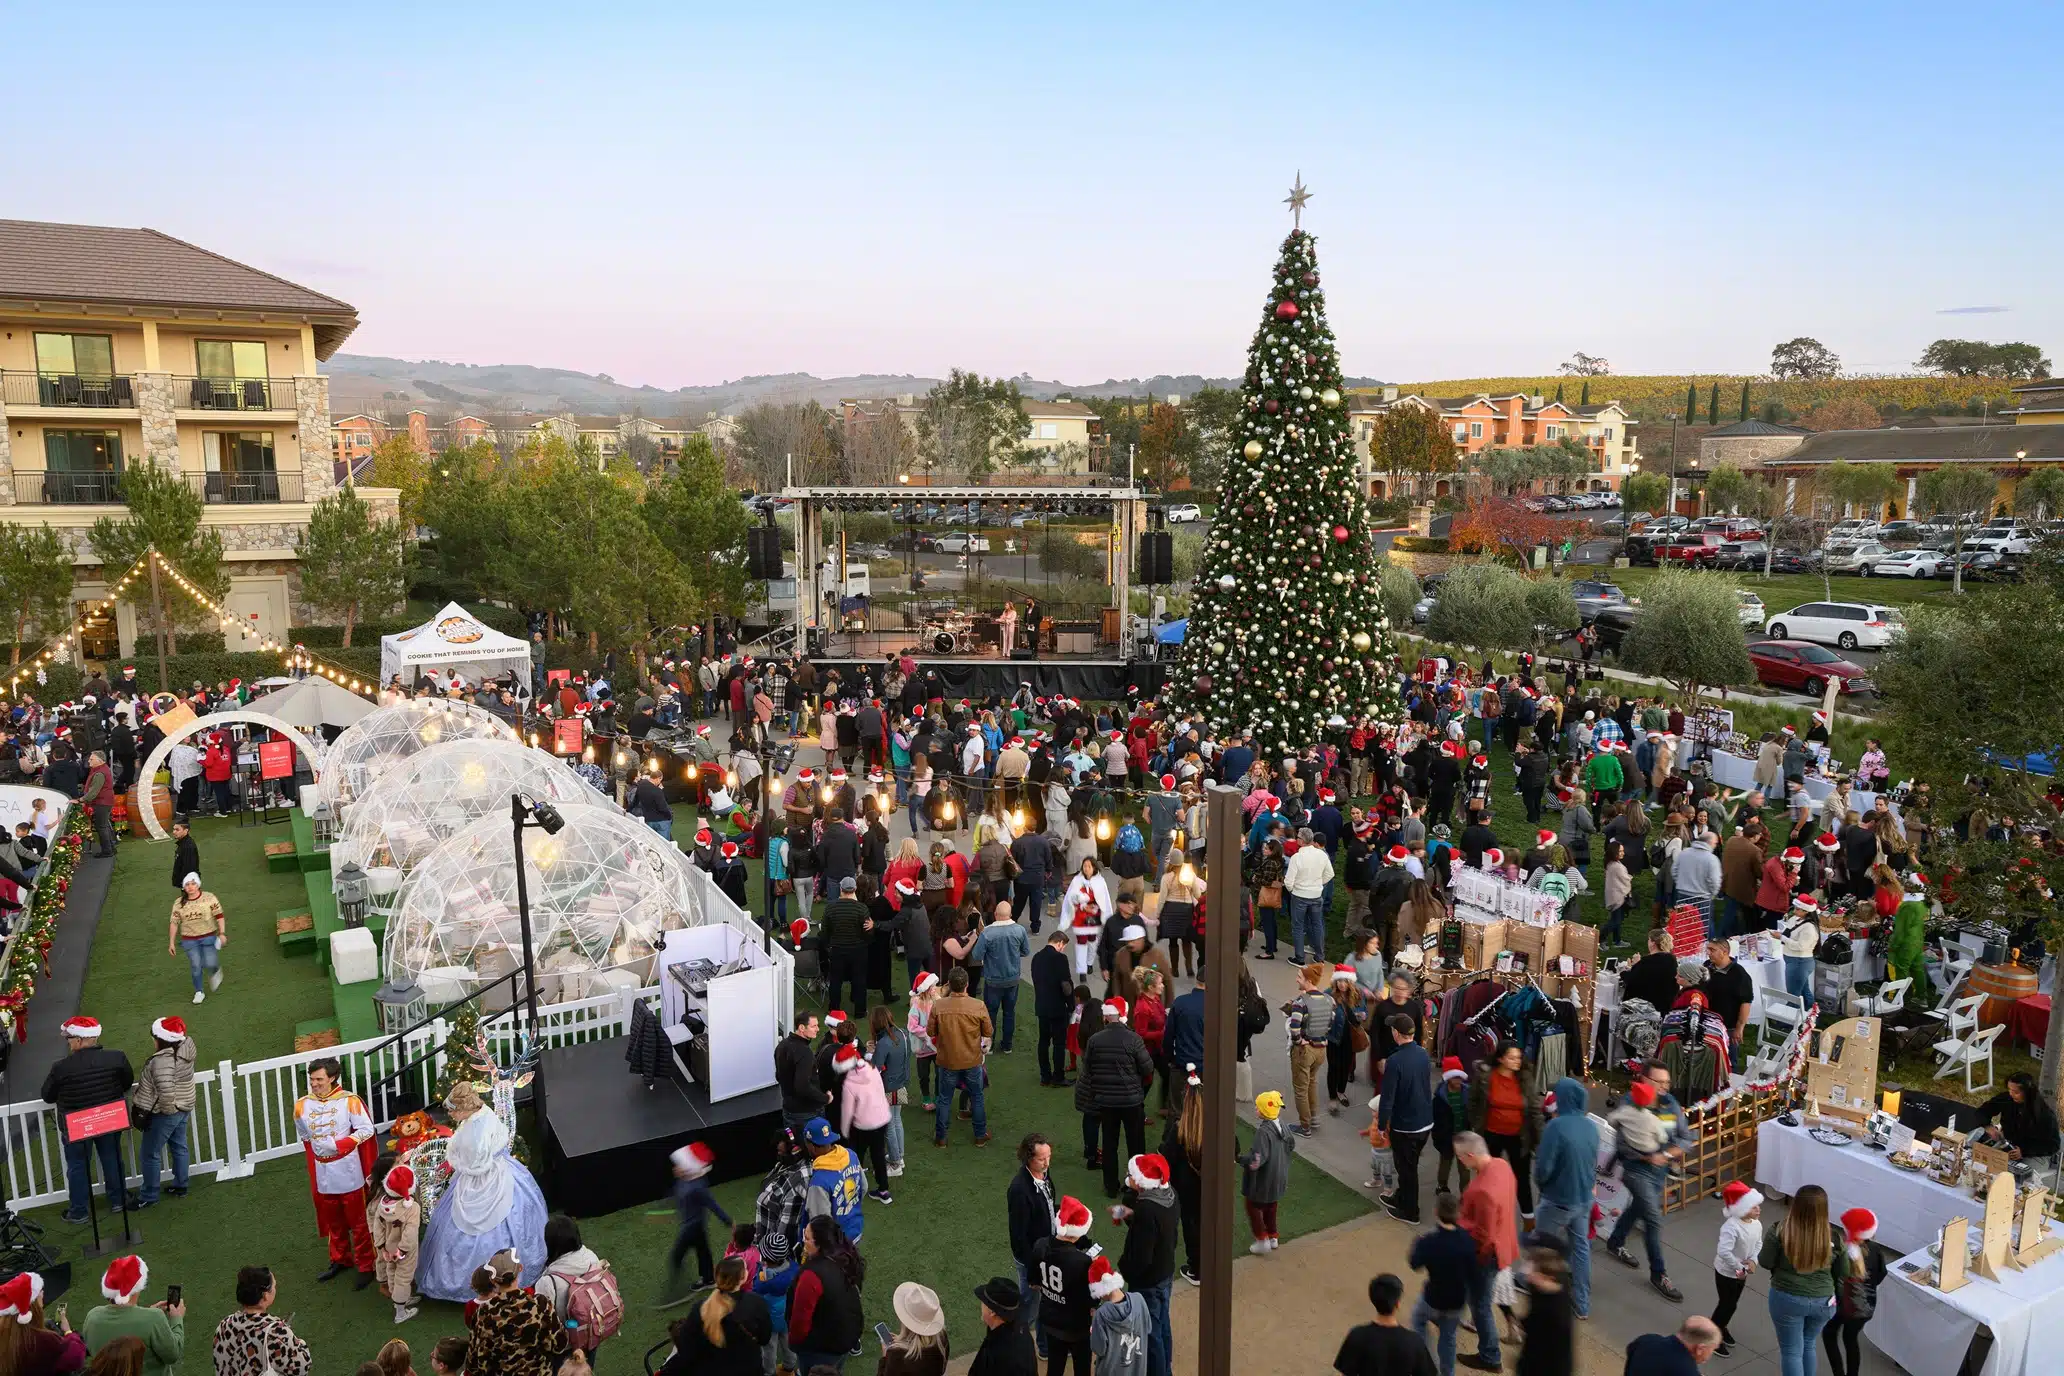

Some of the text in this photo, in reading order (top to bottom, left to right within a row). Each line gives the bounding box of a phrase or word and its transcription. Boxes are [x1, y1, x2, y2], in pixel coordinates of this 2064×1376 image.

[452, 649, 481, 657] REMINDS
[1039, 1261, 1063, 1293] 18
[1041, 1285, 1066, 1305] NICHOLS
